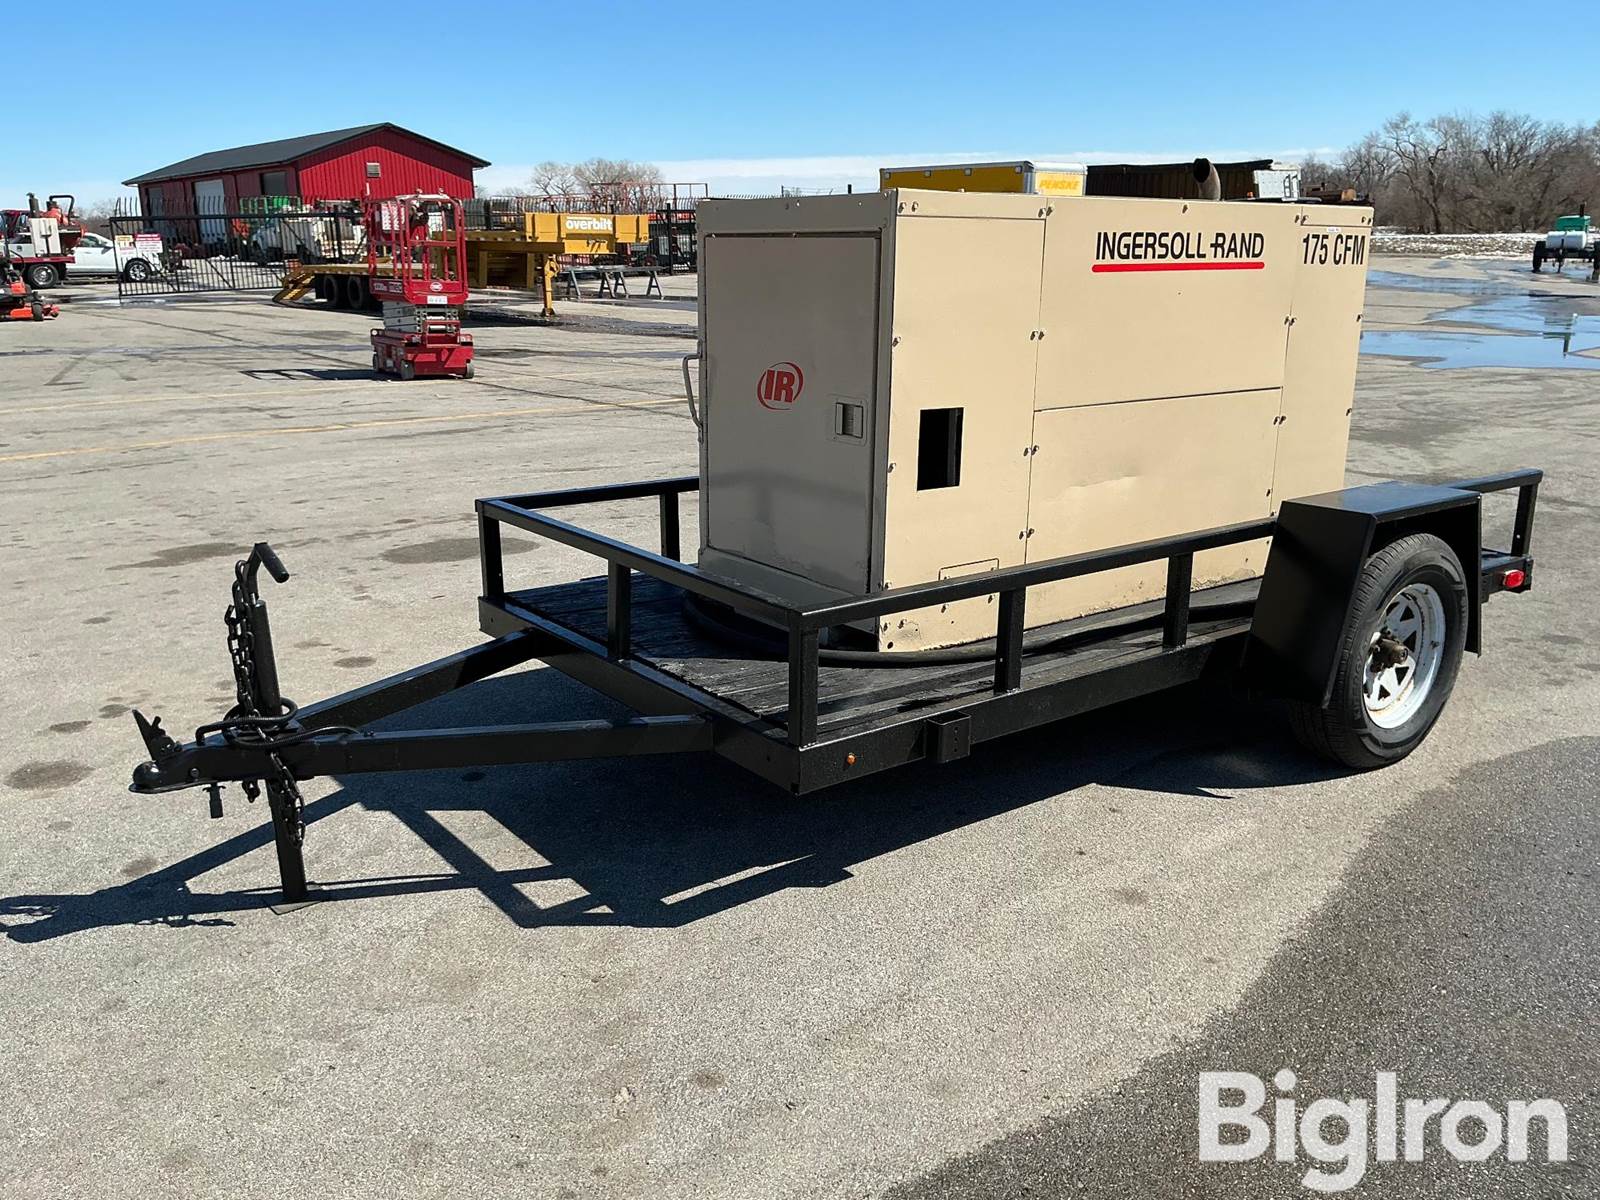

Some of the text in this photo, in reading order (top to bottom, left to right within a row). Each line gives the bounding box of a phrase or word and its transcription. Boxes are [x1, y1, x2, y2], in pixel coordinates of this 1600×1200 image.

[565, 216, 613, 231] overbilt
[1302, 233, 1366, 266] 175 CFM
[763, 369, 796, 403] IR
